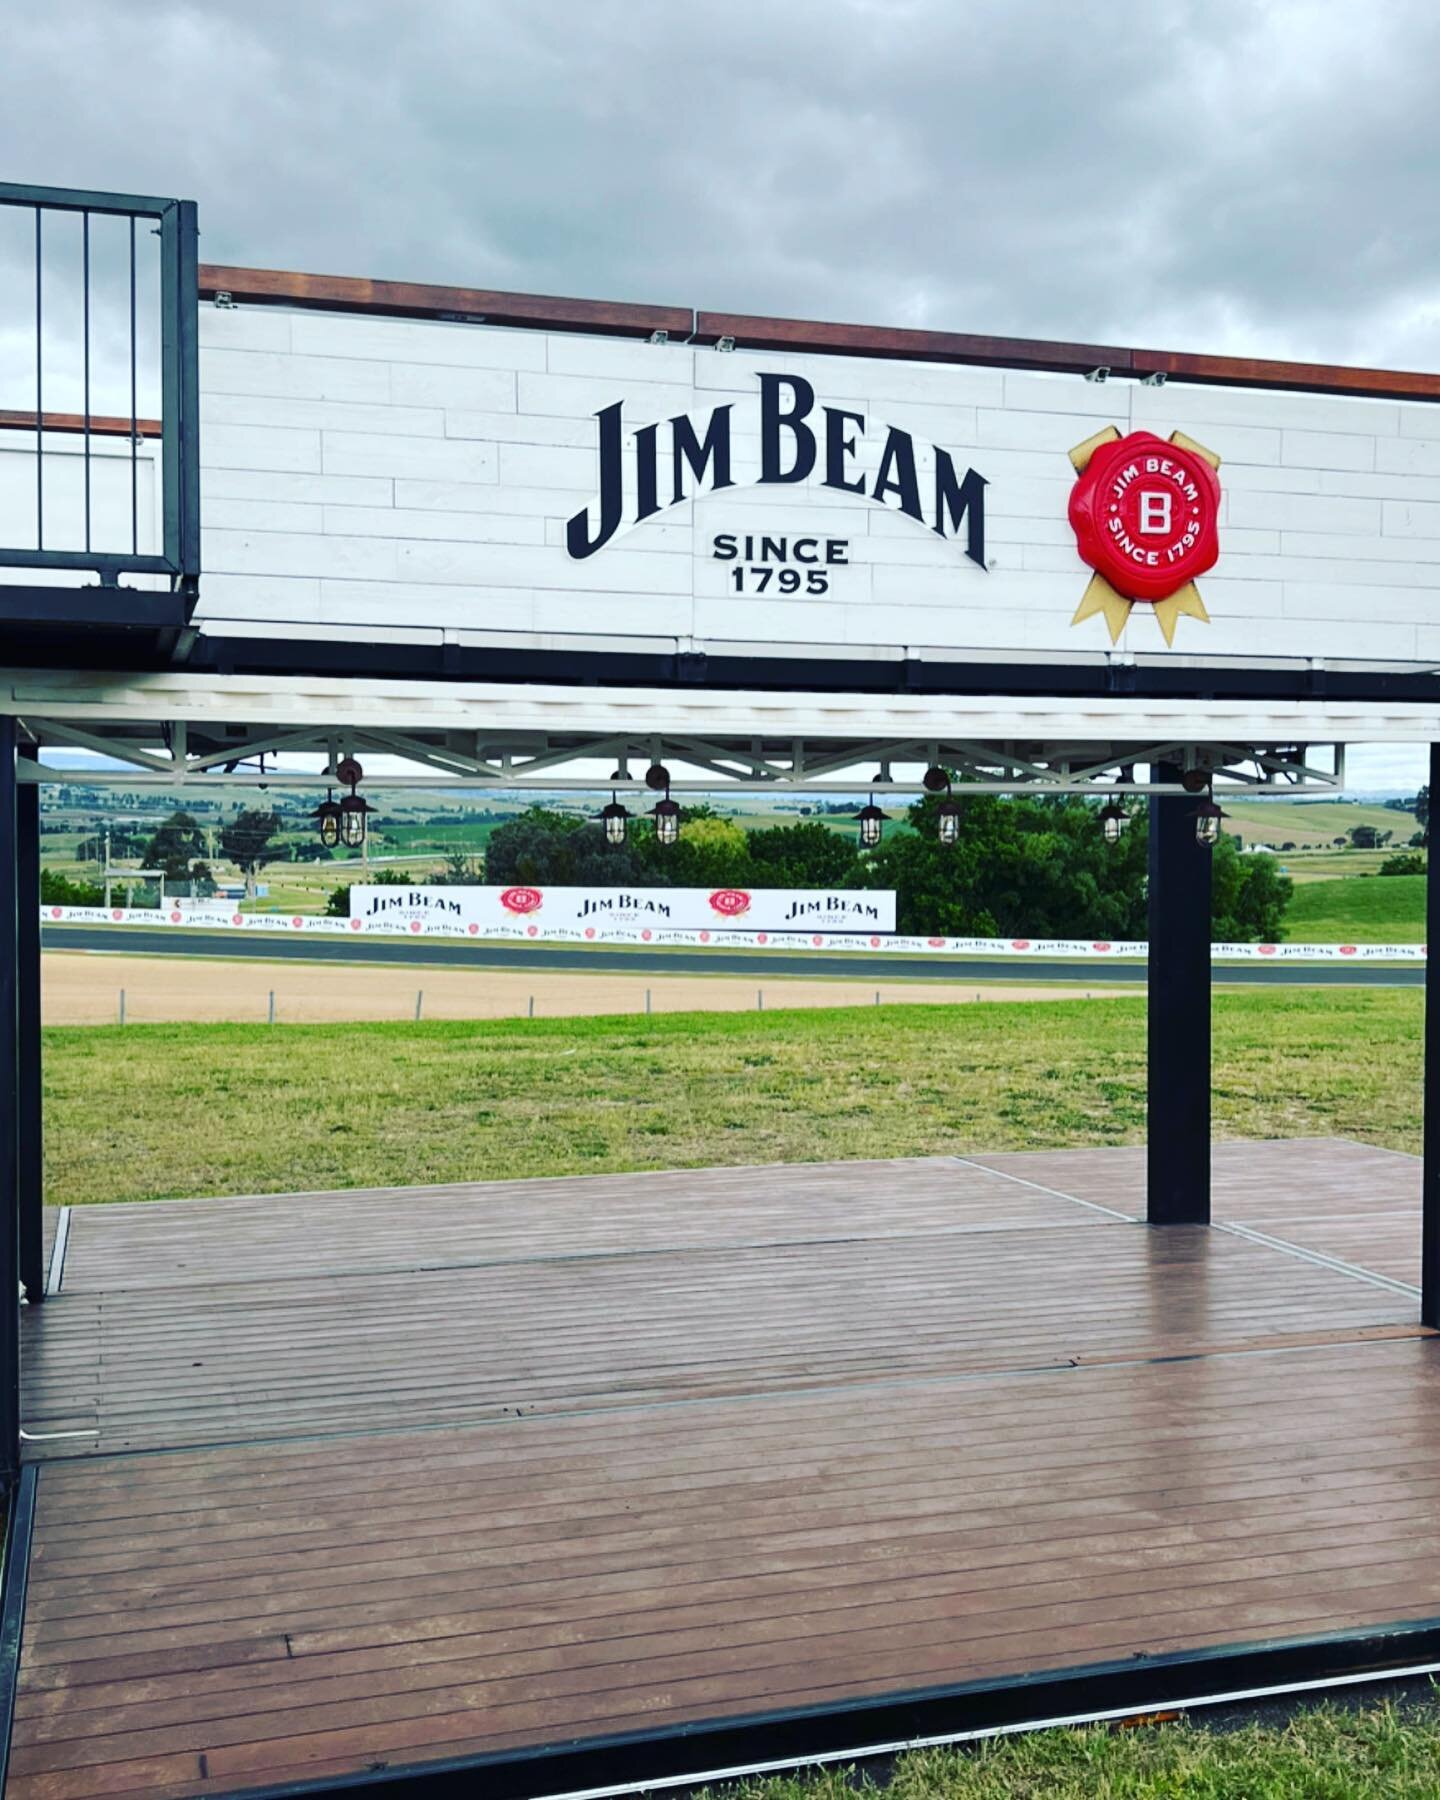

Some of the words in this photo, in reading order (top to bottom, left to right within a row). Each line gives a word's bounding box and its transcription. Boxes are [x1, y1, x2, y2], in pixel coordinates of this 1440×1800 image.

[567, 400, 737, 559] JIM
[755, 372, 990, 573] BEAM
[1111, 464, 1140, 499] JIM
[1146, 458, 1199, 501] BEAM
[1140, 491, 1172, 534] B
[713, 534, 849, 565] SINCE
[1109, 517, 1159, 566] SINCE
[1167, 520, 1200, 562] 1795
[732, 567, 829, 595] 1795
[366, 897, 402, 916] JIM
[409, 892, 461, 915] BEAM
[577, 898, 612, 918] JIM
[619, 894, 670, 917] BEAM
[785, 901, 820, 920] JIM
[827, 897, 878, 920] BEAM
